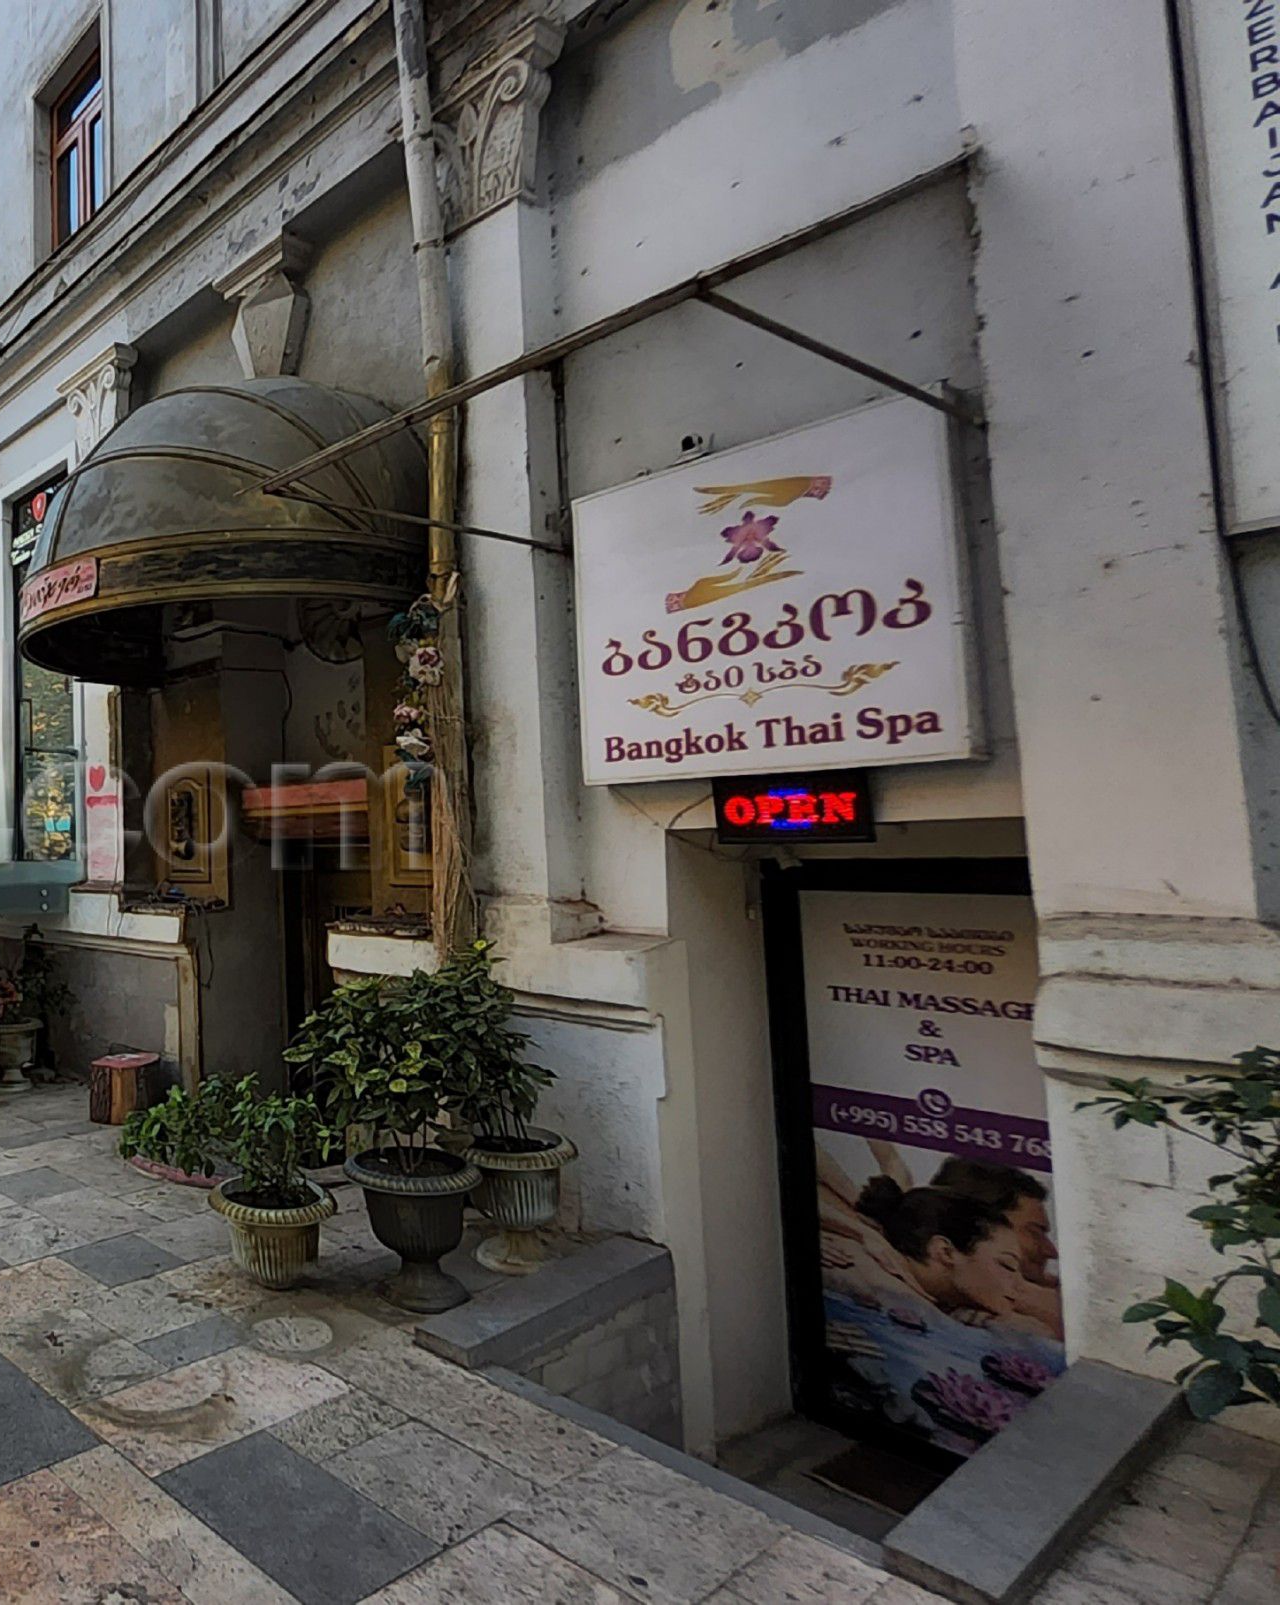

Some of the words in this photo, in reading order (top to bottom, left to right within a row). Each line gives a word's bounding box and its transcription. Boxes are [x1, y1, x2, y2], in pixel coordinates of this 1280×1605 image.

[602, 578, 932, 676] ბანგკოკ
[675, 665, 744, 694] ტაი
[752, 654, 823, 684] სპა
[604, 722, 749, 763] Bangkok
[755, 712, 846, 749] Thai
[855, 707, 943, 745] Spa
[724, 792, 857, 826] OPEN
[849, 936, 936, 953] WORKING
[938, 940, 1007, 957] HOURS
[862, 953, 994, 975] 11:00-24:00
[827, 984, 891, 1007] THAI
[918, 1019, 944, 1038] &
[904, 1043, 962, 1067] SPA
[830, 1102, 898, 1134] (+995)
[904, 1114, 950, 1139] 558
[954, 1124, 1003, 1149] 543
